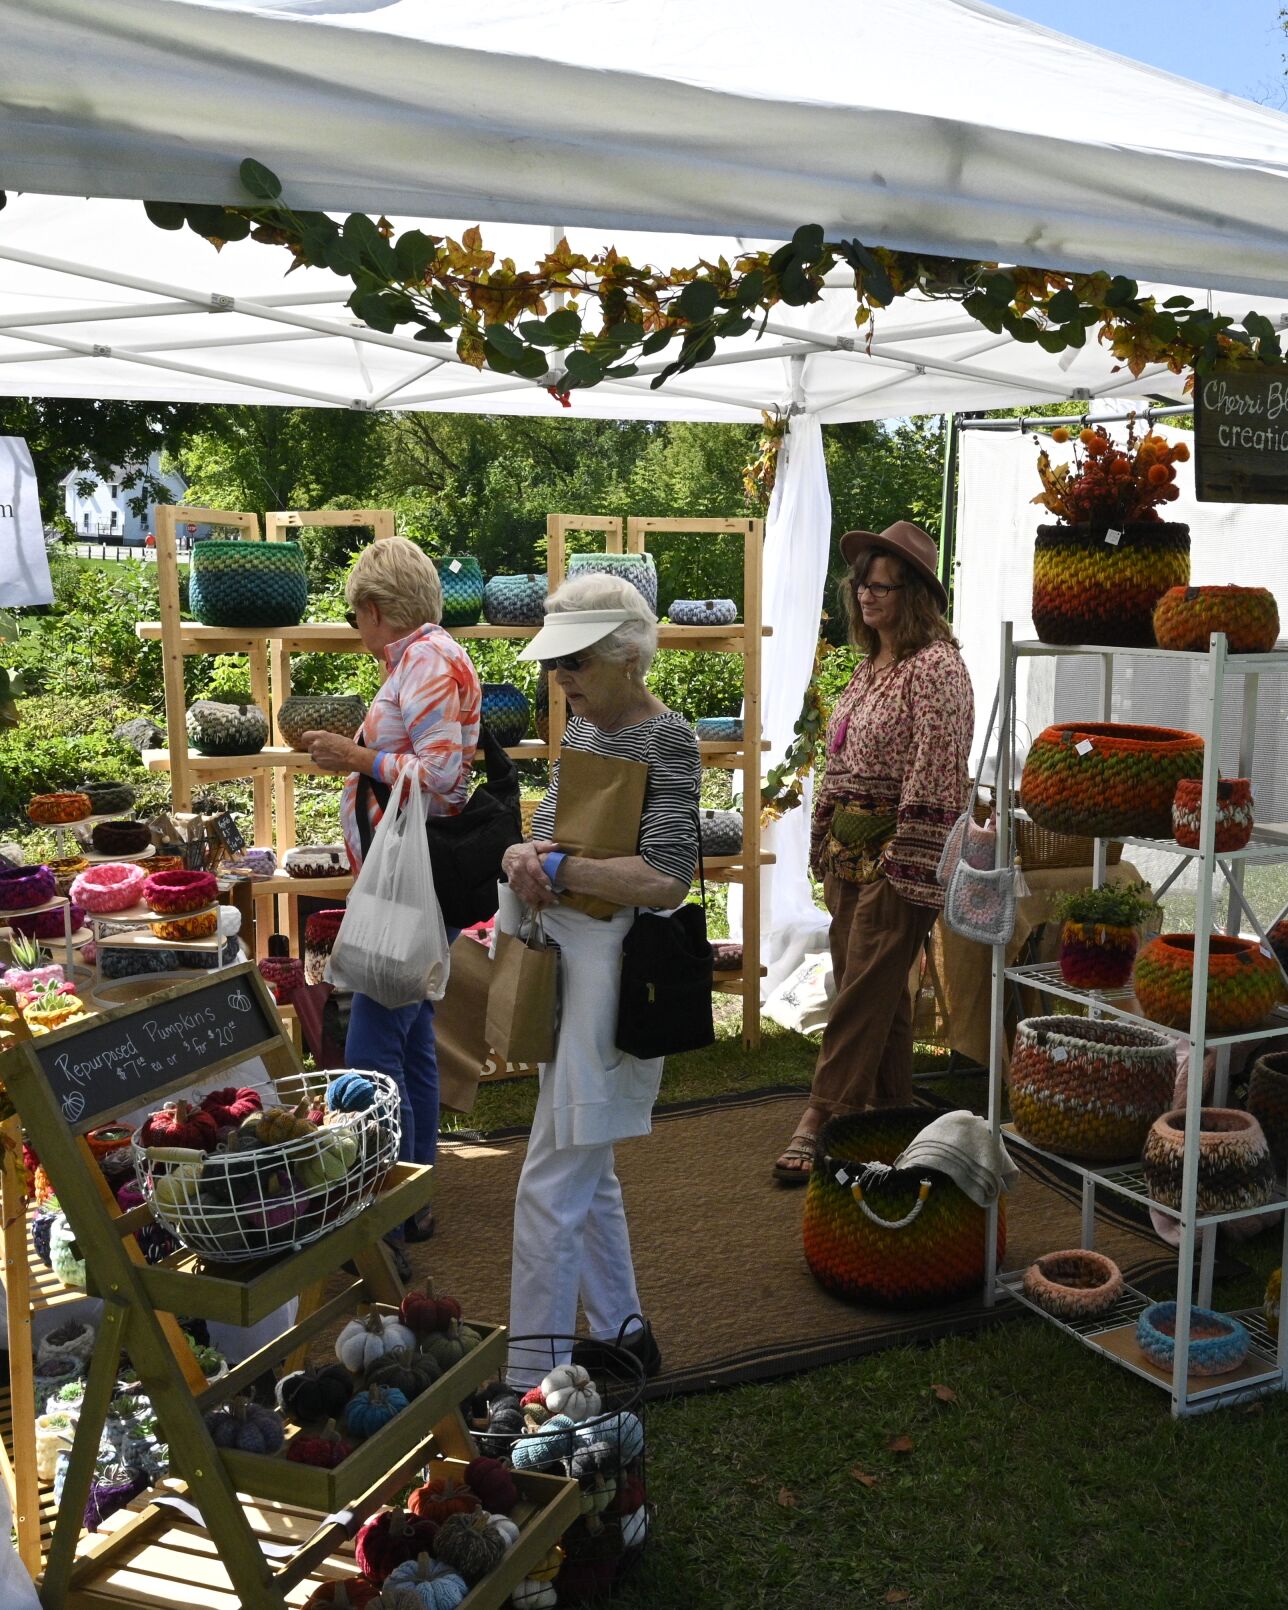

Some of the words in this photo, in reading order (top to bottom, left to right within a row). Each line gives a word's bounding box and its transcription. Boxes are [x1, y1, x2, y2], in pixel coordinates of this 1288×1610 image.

[1203, 379, 1264, 415] Cherri
[54, 1034, 138, 1086] Repurposed
[142, 1007, 216, 1042] Pumpkins
[167, 1054, 178, 1066] or
[192, 1037, 207, 1057] for
